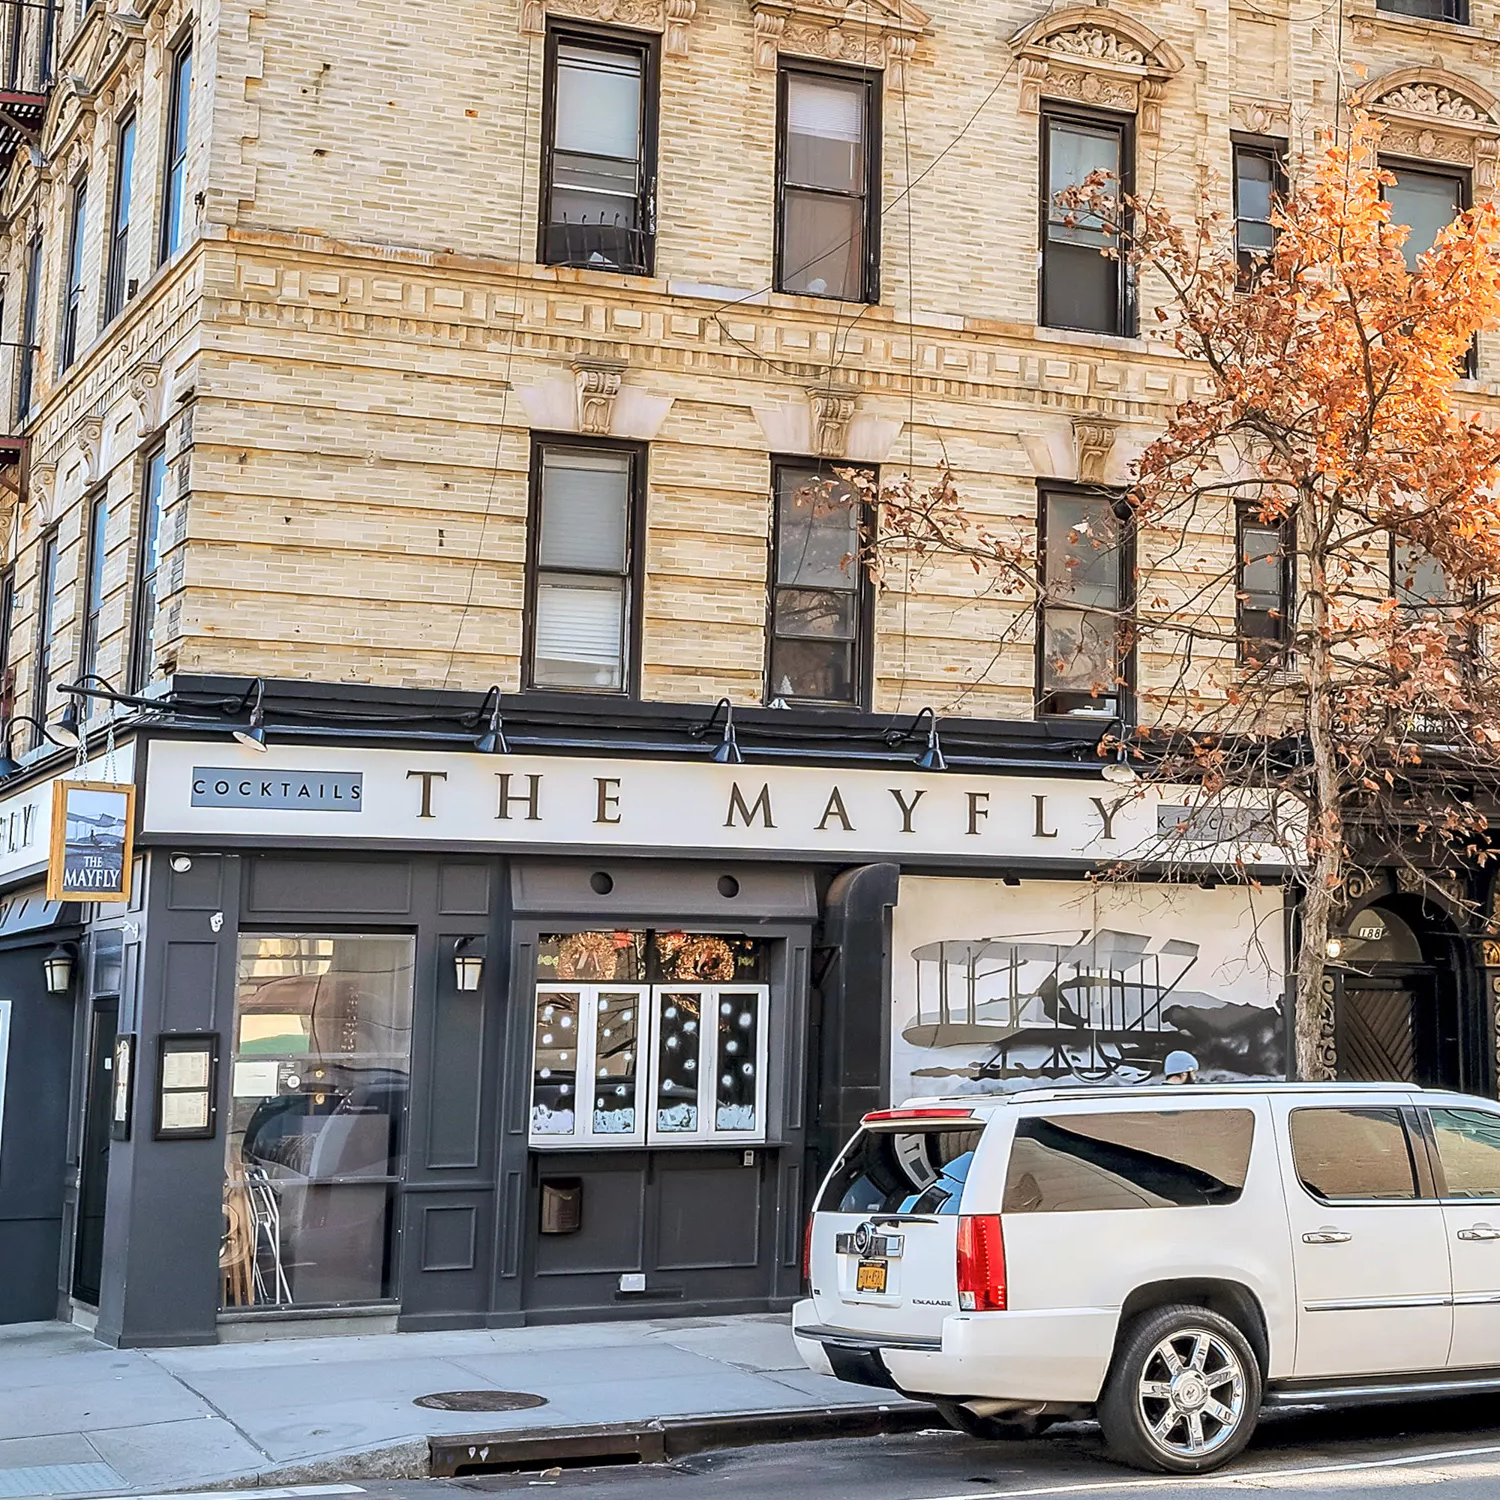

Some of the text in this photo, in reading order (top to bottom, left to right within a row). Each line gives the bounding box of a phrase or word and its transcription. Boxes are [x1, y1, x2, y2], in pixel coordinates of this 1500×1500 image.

[193, 780, 361, 800] COCKTAILS
[406, 770, 1126, 840] THE MAYFLY
[84, 856, 103, 868] THE
[63, 868, 120, 887] MAYFLY
[1363, 928, 1381, 939] 188
